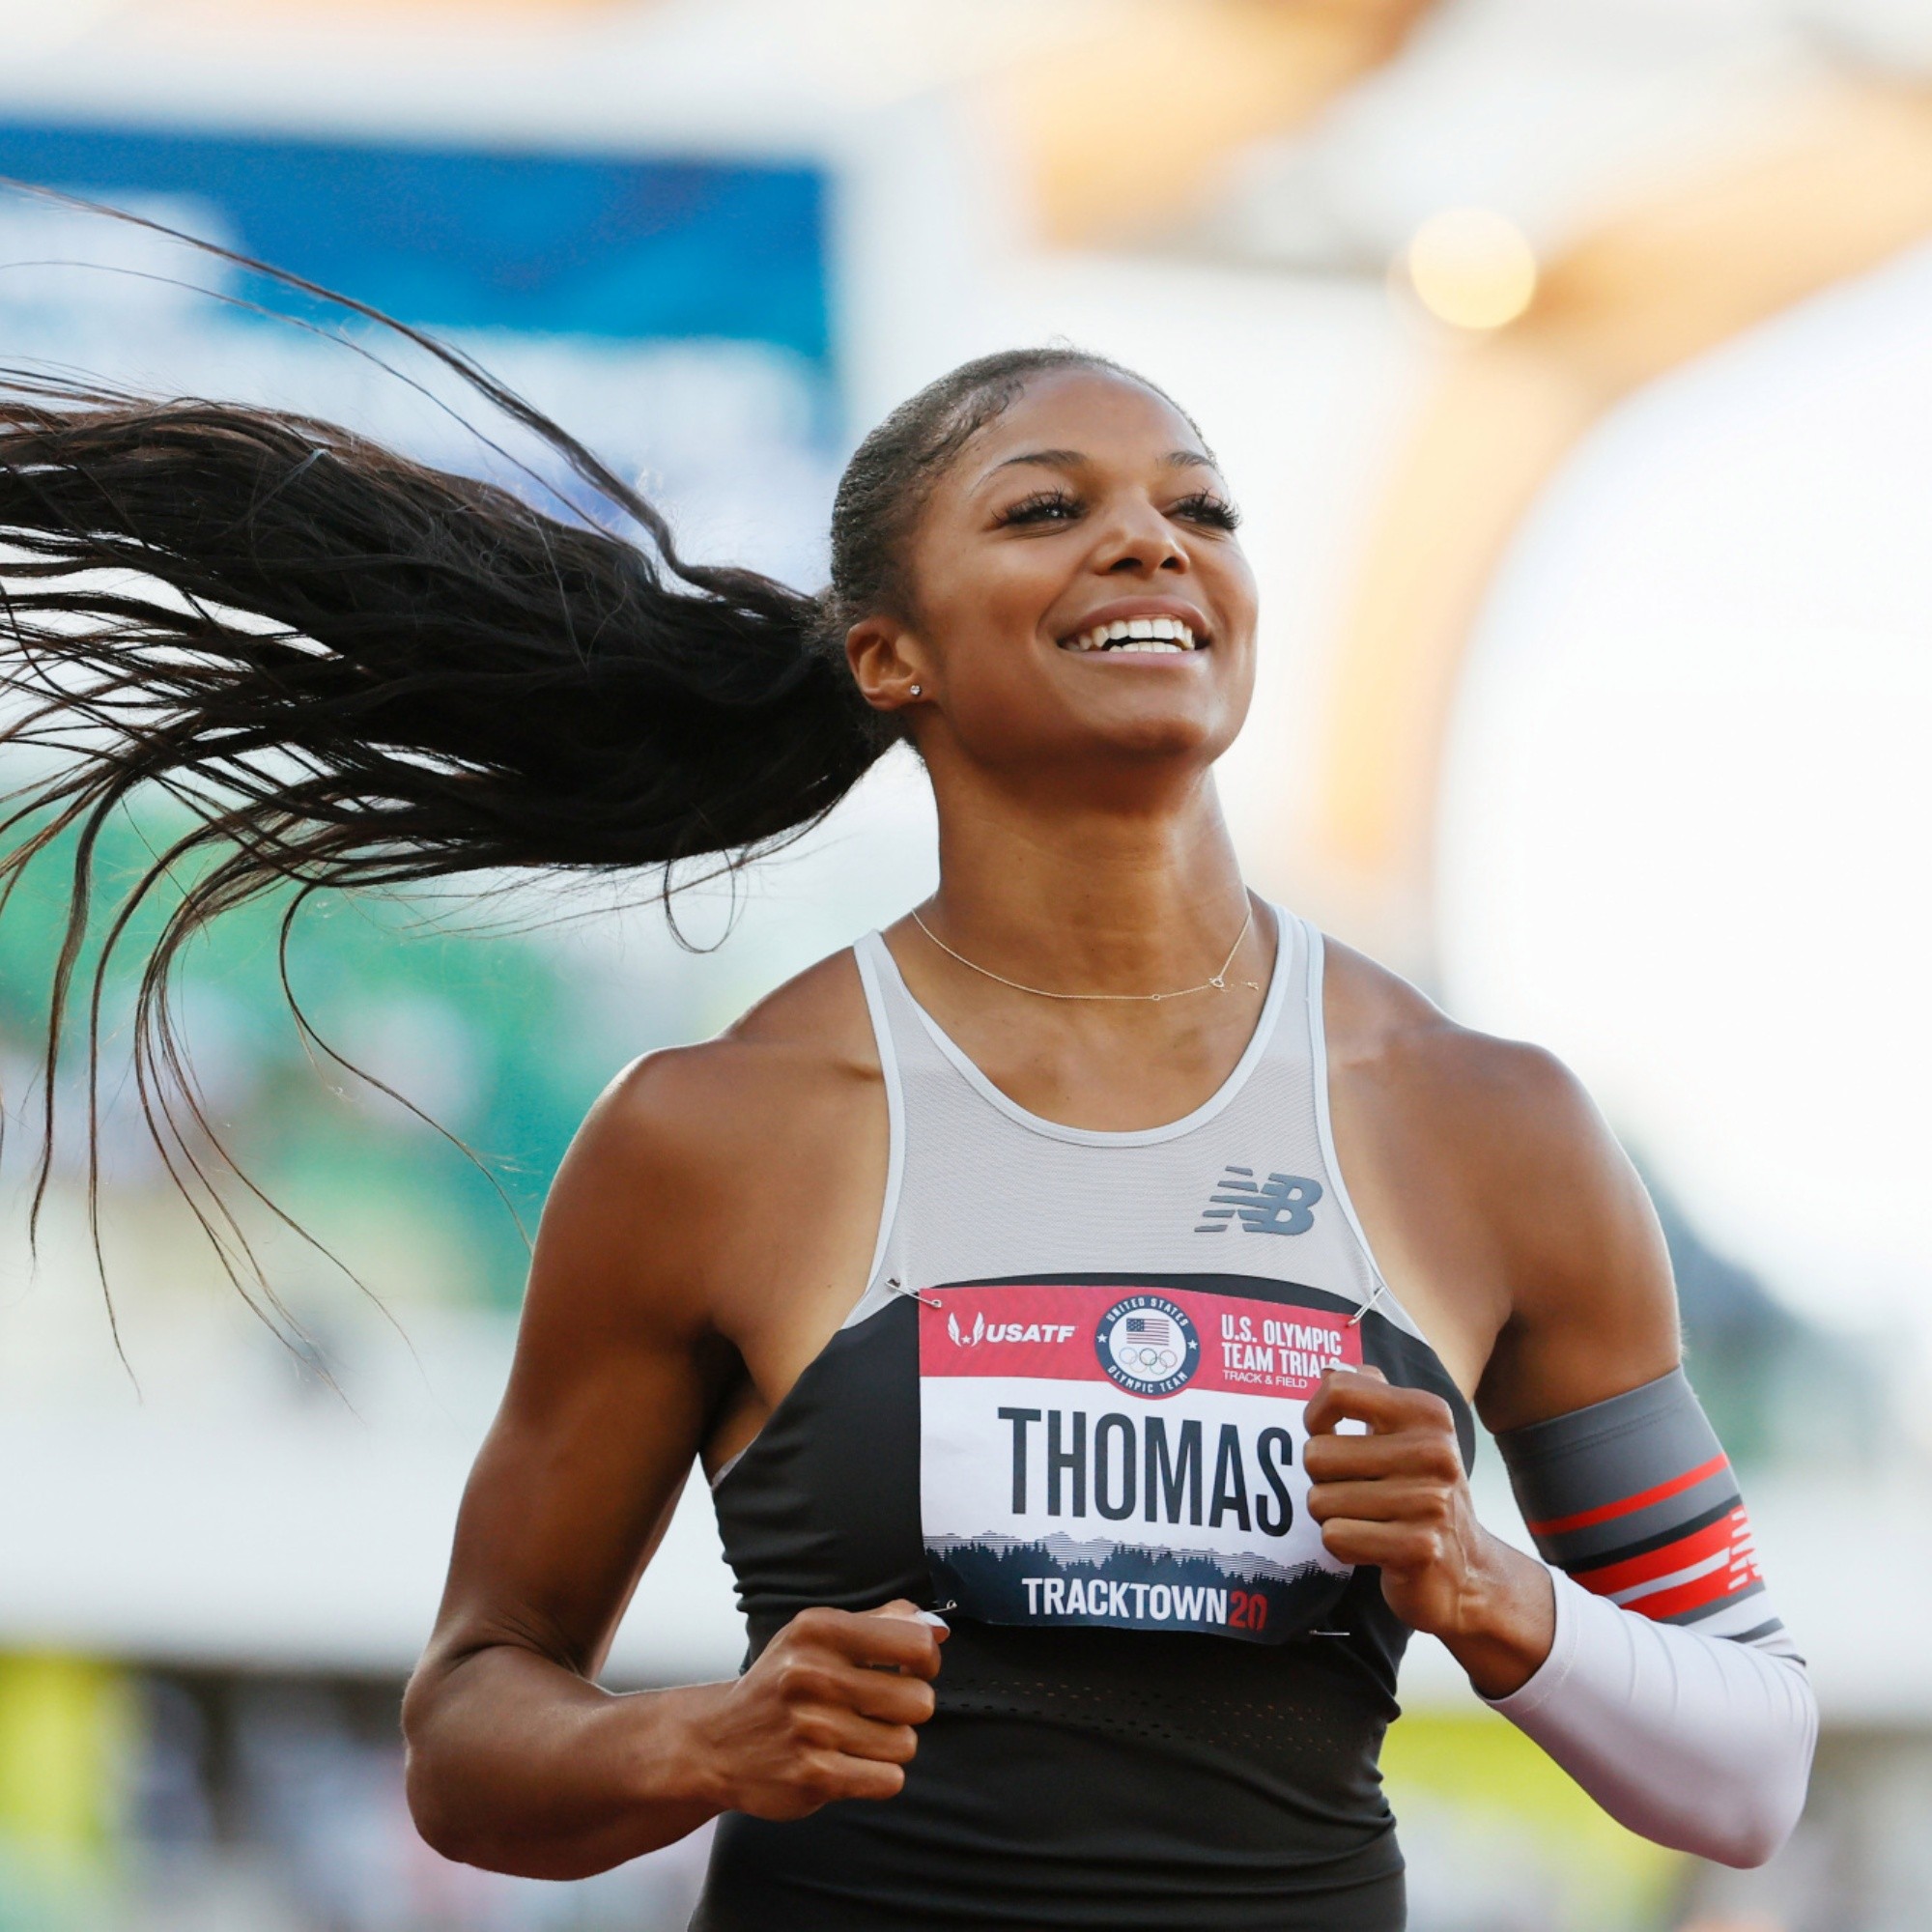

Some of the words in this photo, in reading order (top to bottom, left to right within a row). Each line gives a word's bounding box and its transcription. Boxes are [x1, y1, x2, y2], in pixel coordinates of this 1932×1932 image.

[1106, 1296, 1145, 1322] UNITED
[1151, 1297, 1189, 1327] STATES
[985, 1323, 1076, 1343] USATF
[1221, 1314, 1258, 1344] U.S.
[1264, 1320, 1342, 1356] OLYMPIC
[1222, 1342, 1274, 1374] TEAM
[1107, 1365, 1154, 1393] OLYMPIC
[1159, 1371, 1188, 1393] TEAM
[1223, 1370, 1263, 1383] TRACK
[1264, 1375, 1273, 1385] &
[1275, 1377, 1308, 1389] FIELD
[998, 1406, 1293, 1537] THOMAS
